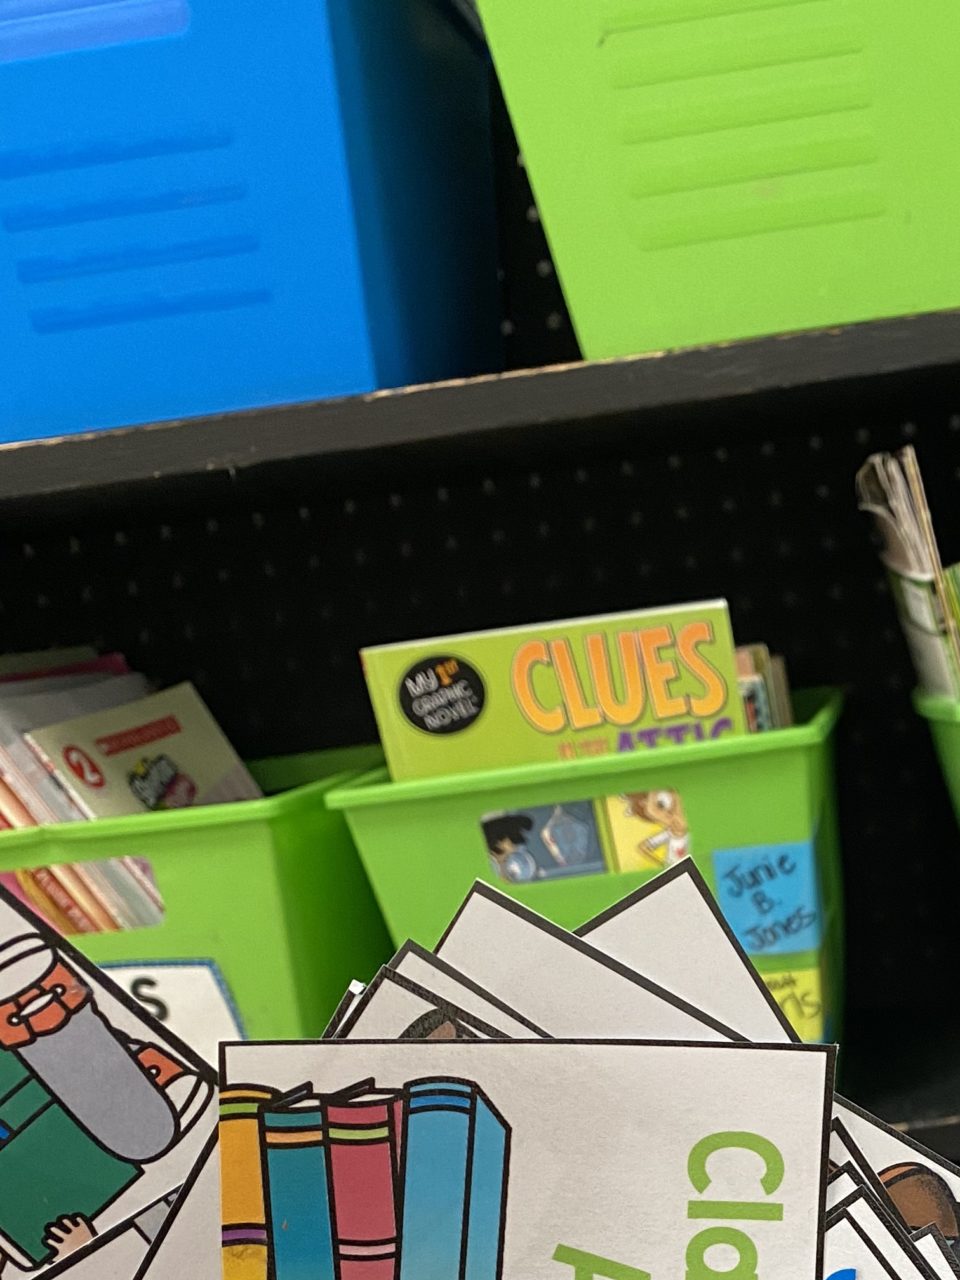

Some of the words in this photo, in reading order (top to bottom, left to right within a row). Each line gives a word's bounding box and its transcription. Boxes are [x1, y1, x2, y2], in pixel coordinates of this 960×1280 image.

[404, 667, 439, 698] MY
[511, 621, 727, 734] CLUES
[69, 748, 102, 786] 2
[723, 853, 797, 898] Junie
[743, 905, 818, 950] Jones
